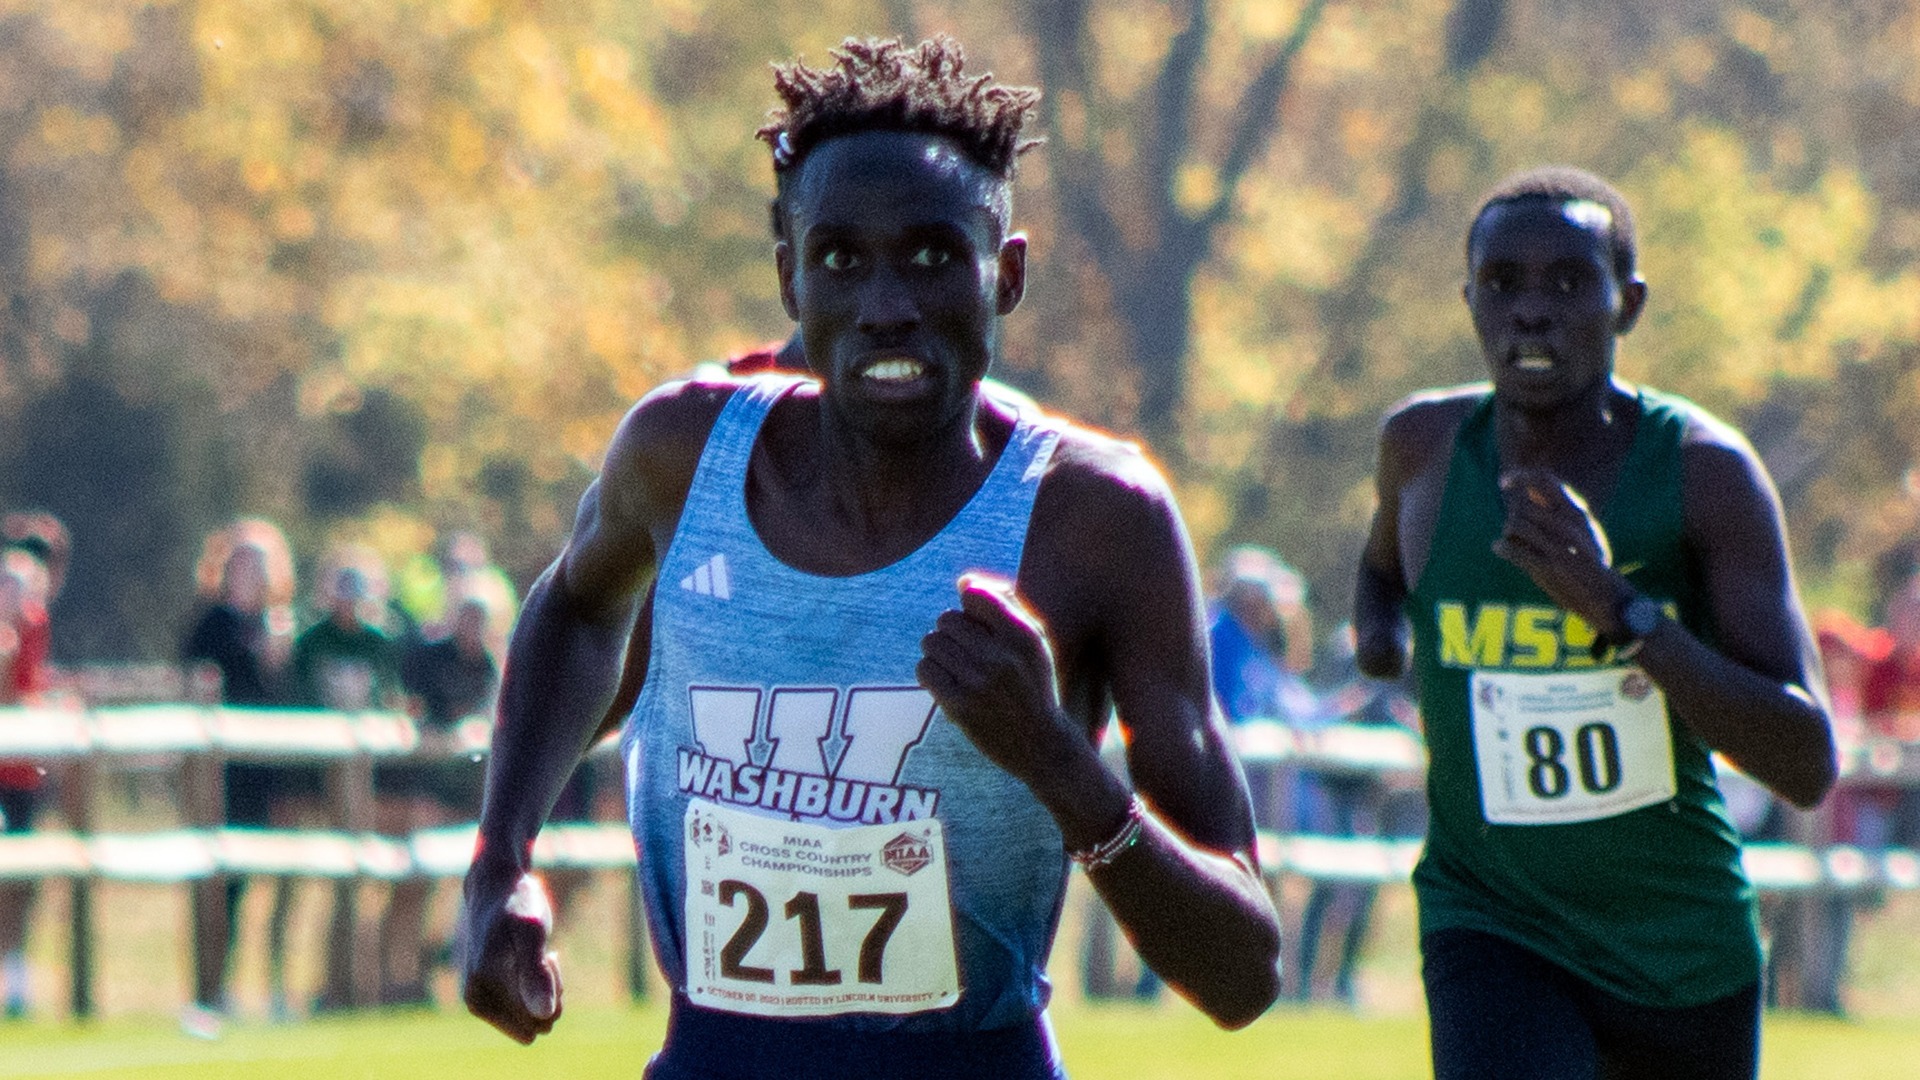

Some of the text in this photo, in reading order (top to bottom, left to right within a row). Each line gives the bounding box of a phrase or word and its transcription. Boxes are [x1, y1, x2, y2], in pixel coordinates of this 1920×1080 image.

[1523, 721, 1624, 801] 80
[676, 746, 942, 824] WASHBURN
[739, 841, 872, 864] CROSS COUNTRY
[783, 835, 823, 849] MIAA
[884, 846, 930, 861] MIAA
[740, 856, 873, 878] CHAMPIONSHIPS
[718, 879, 910, 986] 217
[707, 985, 744, 1000] OCTOBER
[836, 993, 876, 1003] LINCOLN
[877, 991, 934, 1003] UNIVERSITY
